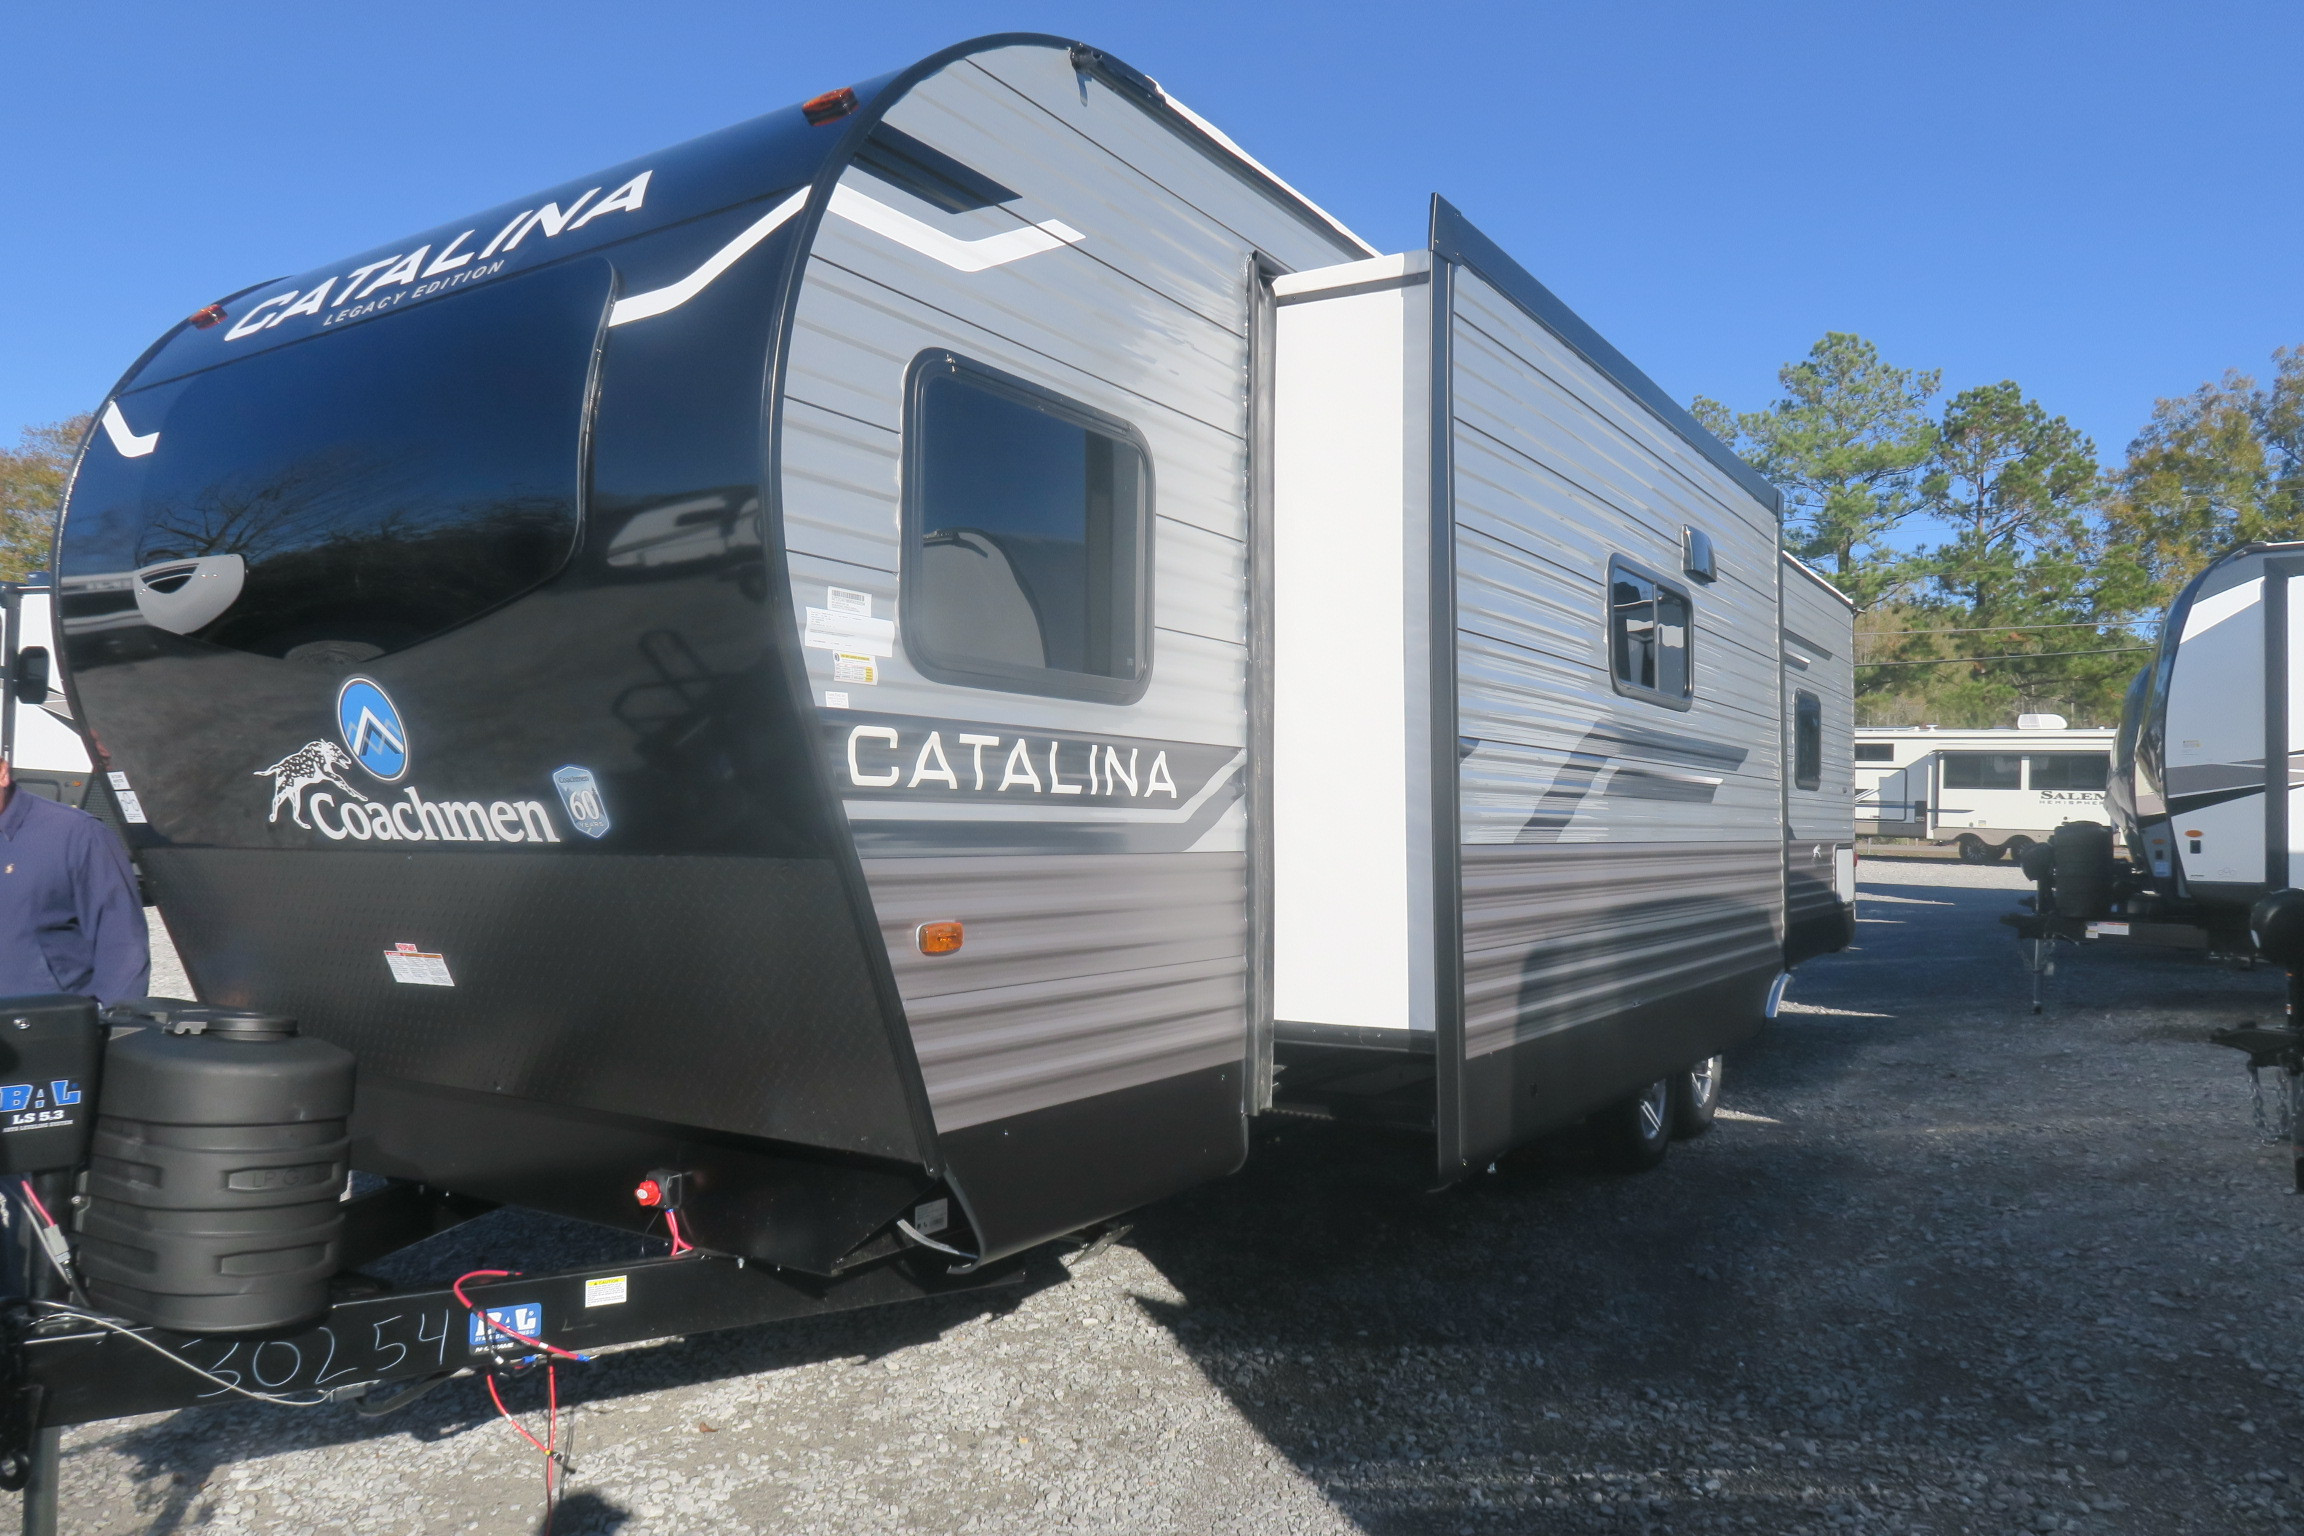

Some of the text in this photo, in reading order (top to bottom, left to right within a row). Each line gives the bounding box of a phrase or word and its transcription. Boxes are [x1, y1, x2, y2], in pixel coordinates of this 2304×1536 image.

[224, 170, 653, 342] CATALINA
[323, 259, 505, 327] LEGACY EDITION
[847, 725, 1177, 799] CATALINA
[309, 786, 561, 843] Coachmen
[570, 790, 600, 820] 60
[12, 1110, 65, 1124] LS 5.3
[181, 1309, 449, 1398] 30254
